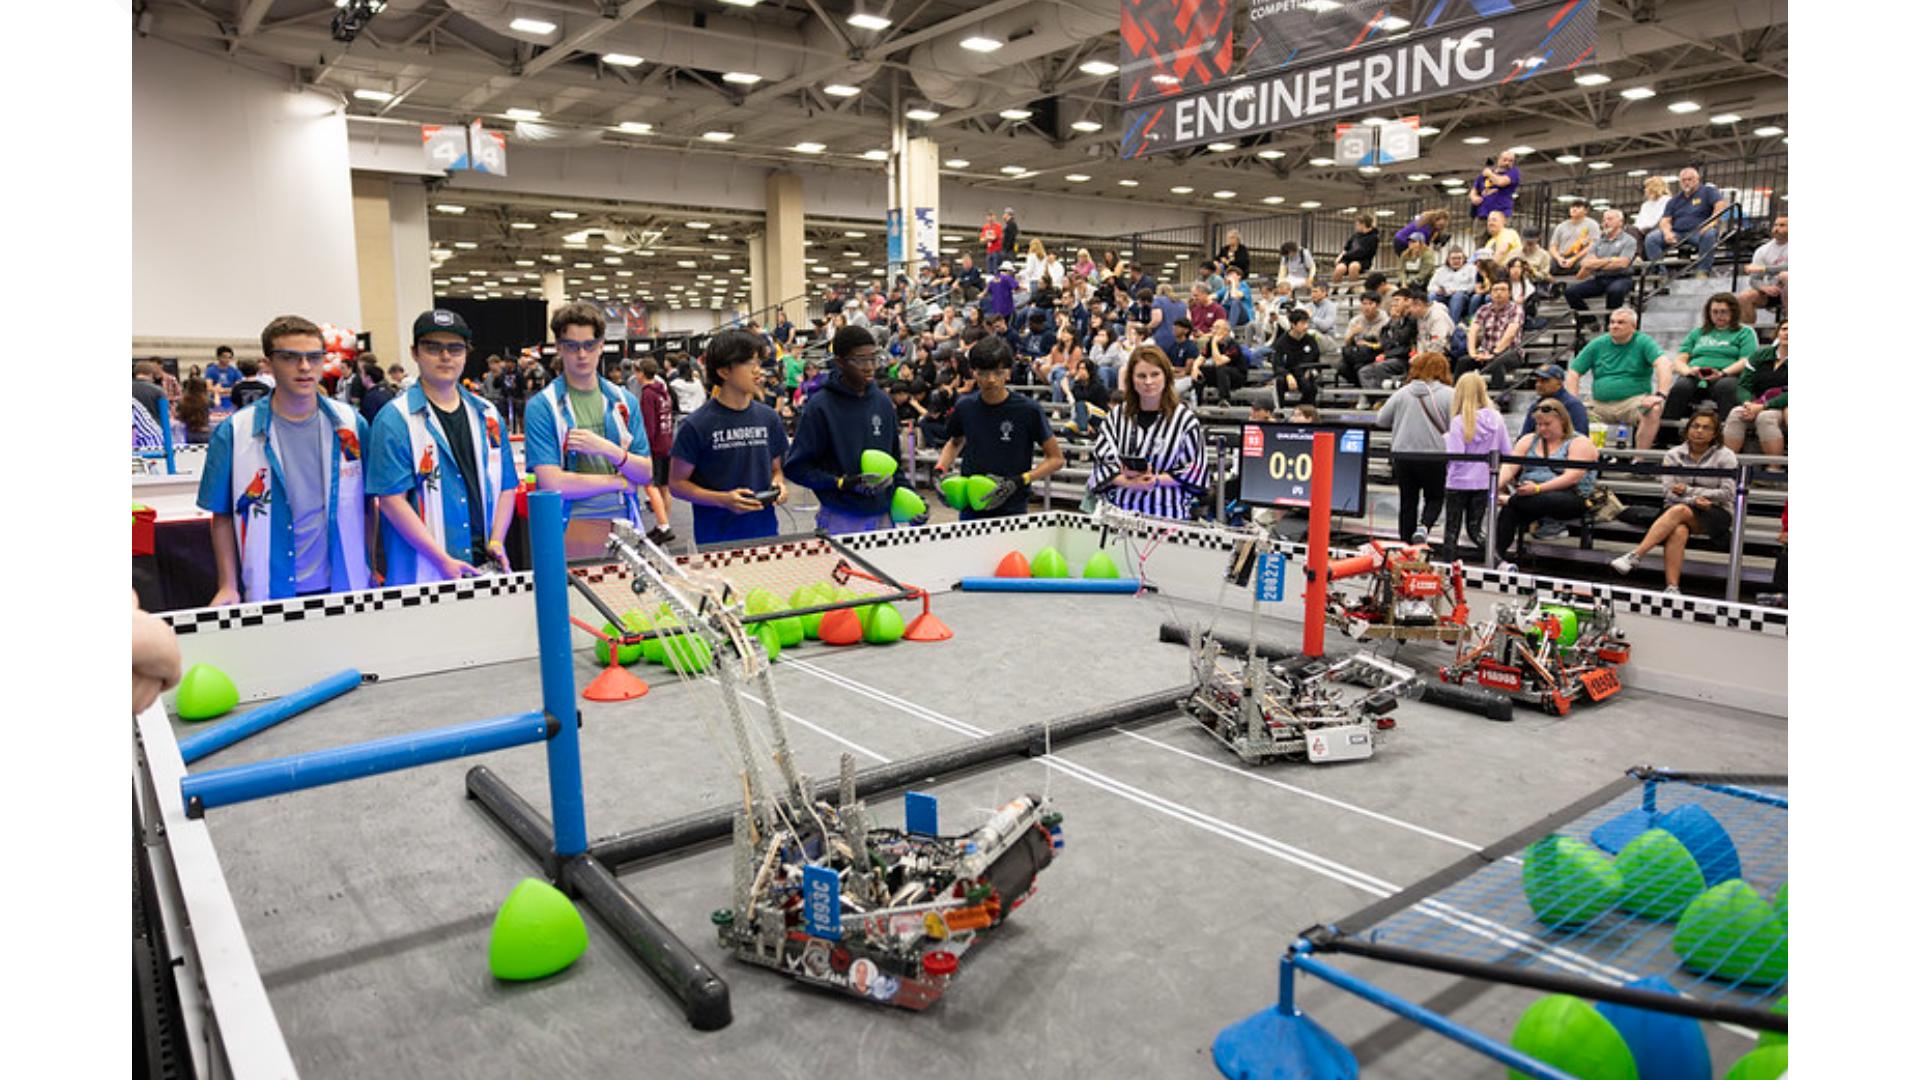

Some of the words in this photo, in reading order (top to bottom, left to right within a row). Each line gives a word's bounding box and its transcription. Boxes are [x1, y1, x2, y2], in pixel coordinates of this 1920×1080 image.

[1250, 0, 1297, 20] COMPET
[1175, 27, 1496, 142] ENGINEERING
[433, 142, 456, 163] 4
[1343, 137, 1364, 159] 3
[1269, 451, 1313, 481] 0:0
[812, 879, 831, 933] 1893C
